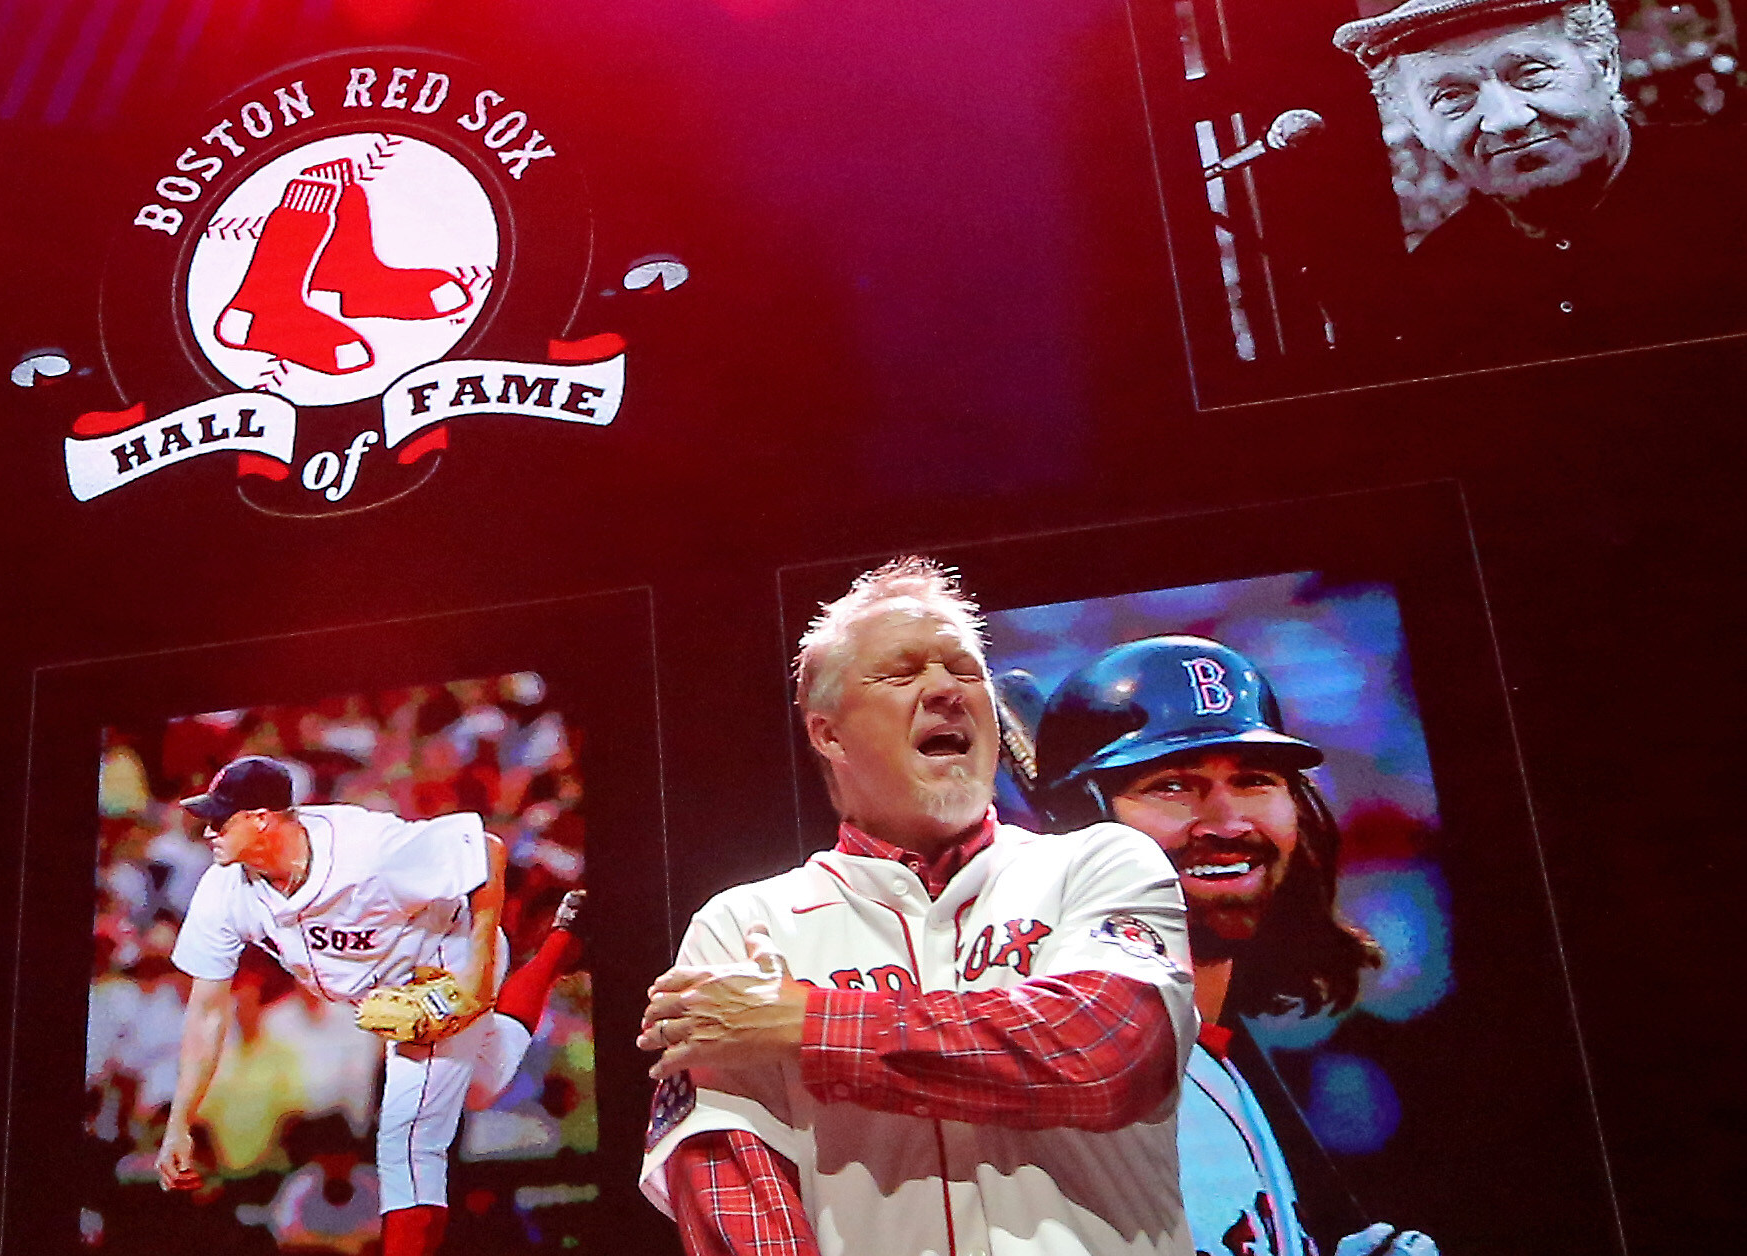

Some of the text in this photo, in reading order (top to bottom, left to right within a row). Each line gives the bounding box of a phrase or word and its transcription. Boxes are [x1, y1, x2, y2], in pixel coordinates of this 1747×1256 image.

[133, 66, 557, 236] BOSTON RED SOX
[110, 374, 606, 502] HALL of FAME
[1181, 656, 1234, 716] B
[309, 926, 377, 951] SOX
[955, 918, 1052, 982] OX
